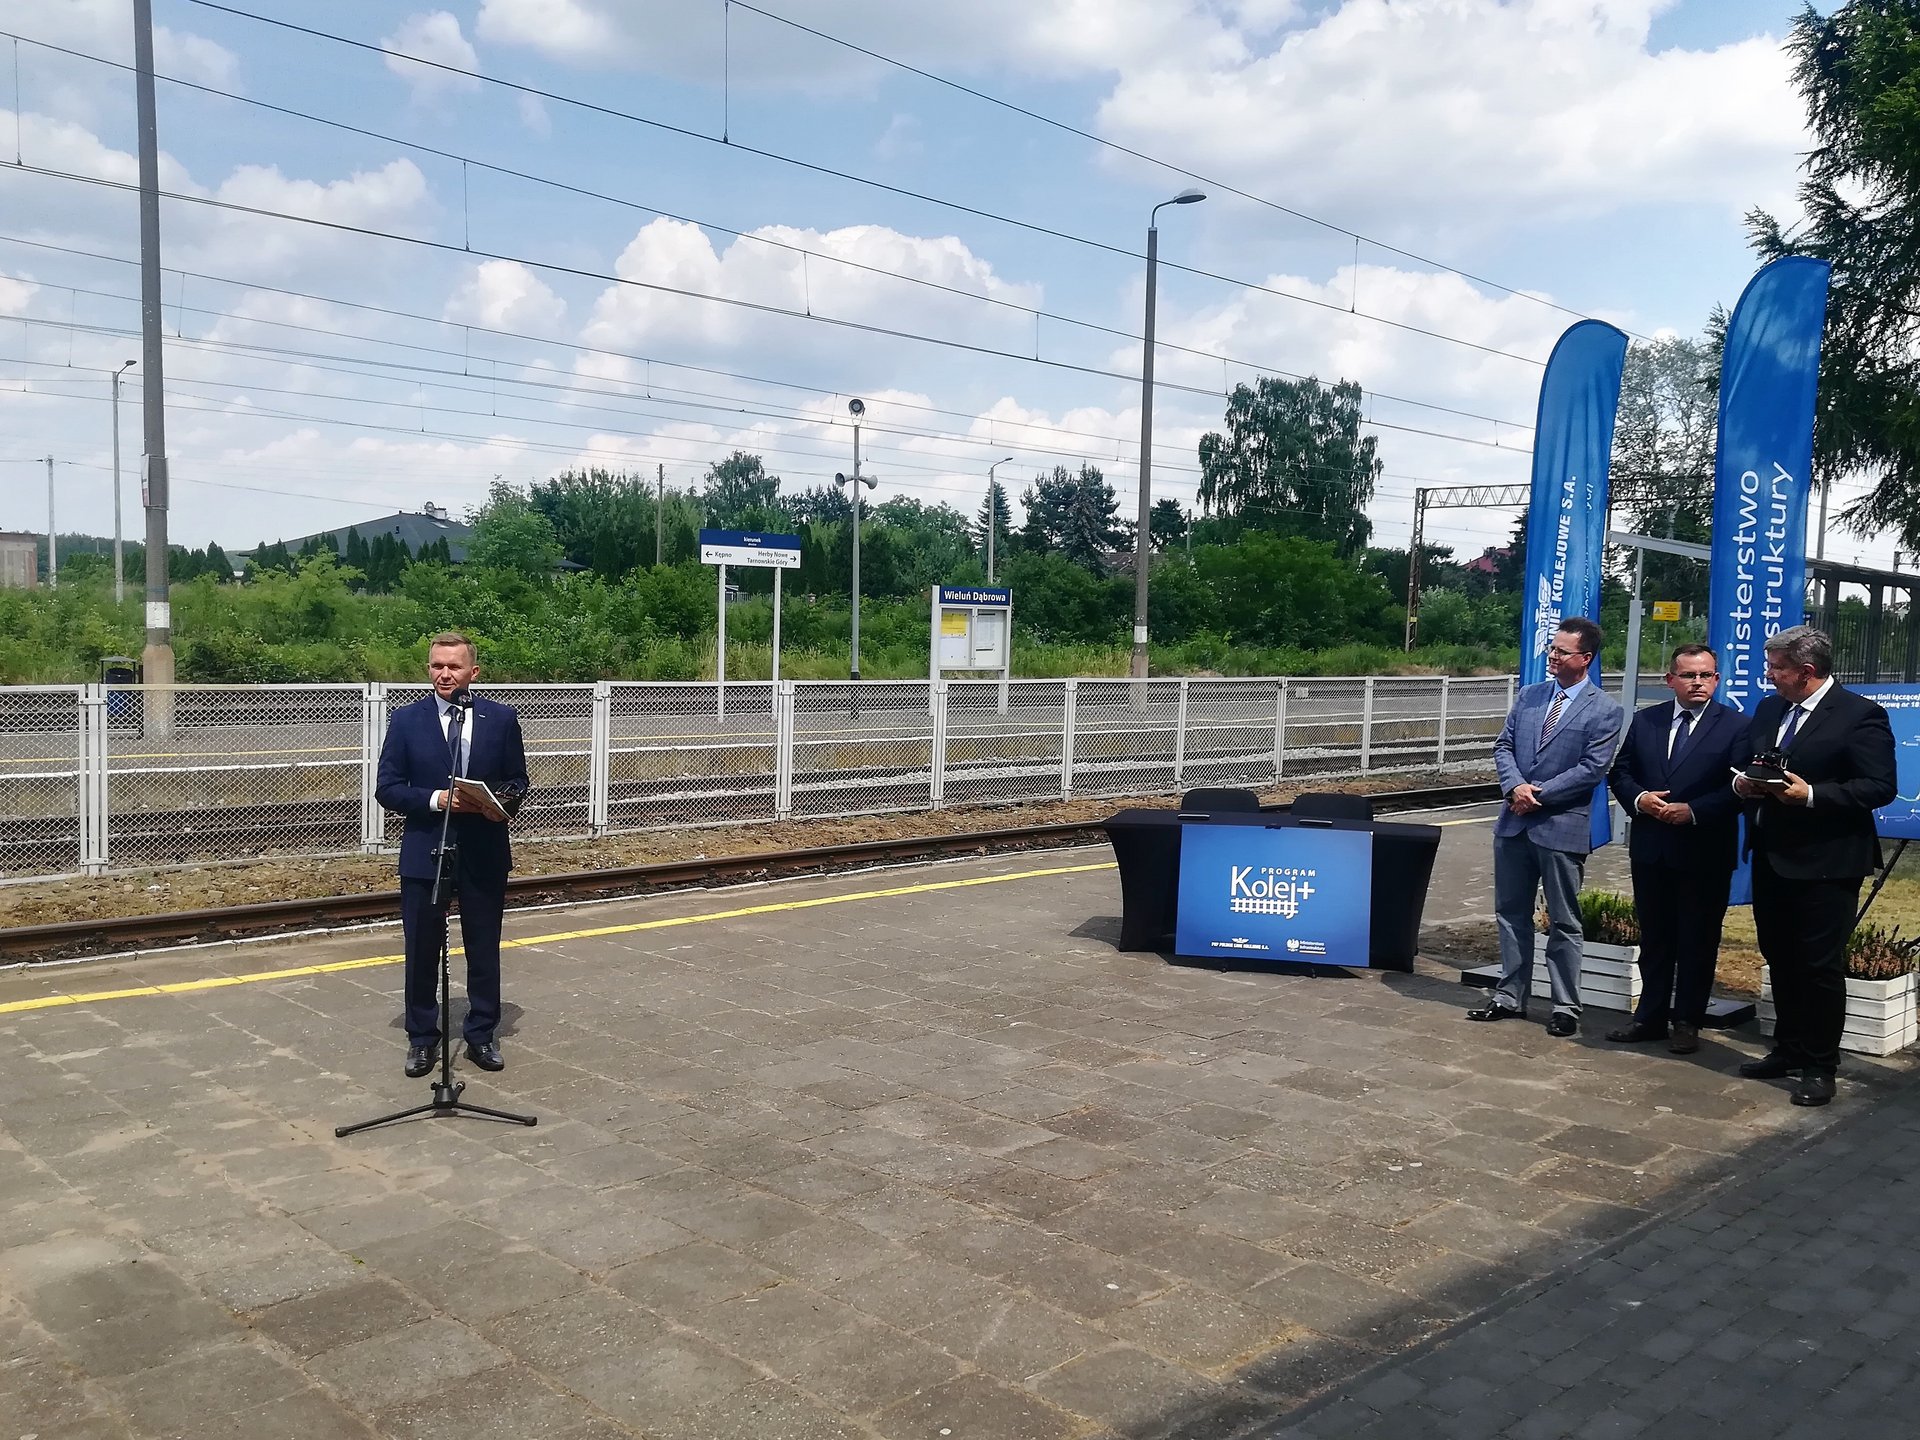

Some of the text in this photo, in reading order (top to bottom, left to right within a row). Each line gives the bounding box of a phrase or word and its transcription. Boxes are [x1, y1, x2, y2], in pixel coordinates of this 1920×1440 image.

[1561, 475, 1577, 509] S.A.
[714, 551, 733, 559] Kępno
[775, 558, 789, 566] Góry
[1551, 514, 1572, 602] KOLEJOWE
[944, 590, 1006, 602] Wieluń Dąbrowa
[1540, 604, 1550, 629] PLK
[1261, 866, 1316, 877] PROGRAM
[1230, 865, 1316, 919] Kolej+
